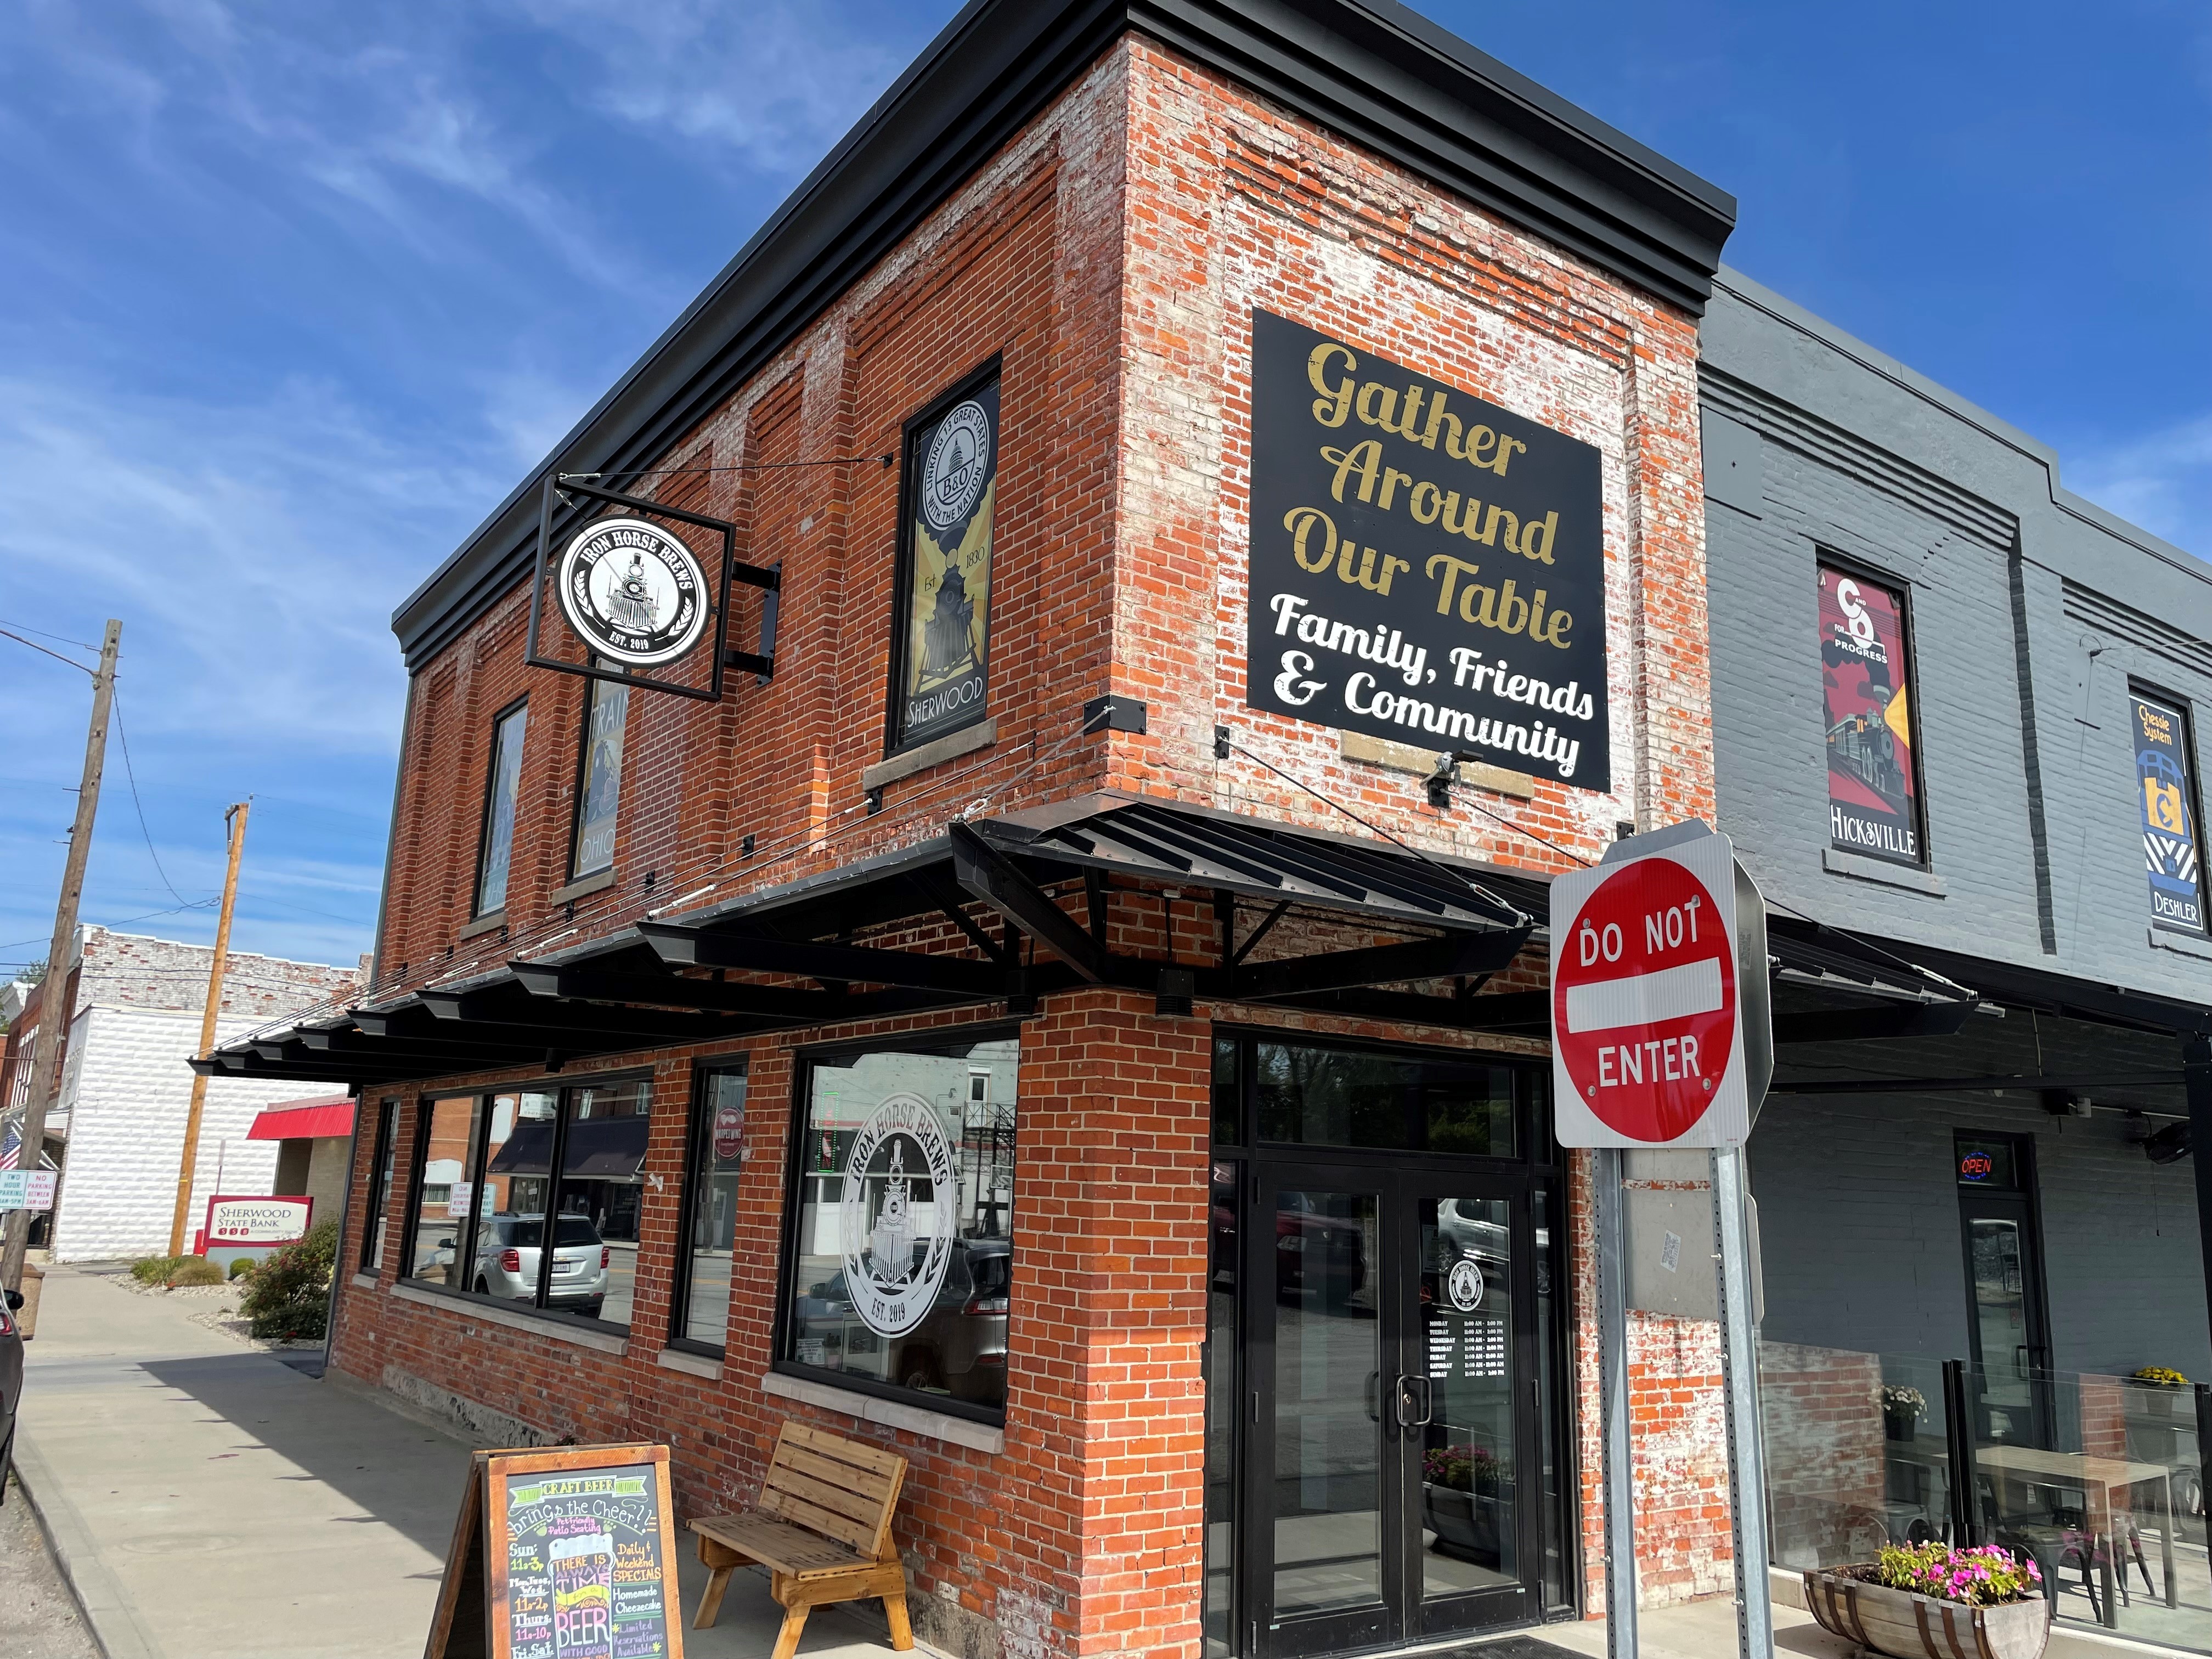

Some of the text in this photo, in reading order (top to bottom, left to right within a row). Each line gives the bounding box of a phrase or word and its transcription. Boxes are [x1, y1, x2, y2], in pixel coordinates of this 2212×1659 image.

[1307, 342, 1526, 476] Gather
[927, 409, 985, 492] LINKING 13 GREAT STATES
[928, 467, 981, 523] WITH THE NATION
[943, 467, 968, 498] B&O
[1320, 440, 1559, 565] Around
[580, 531, 693, 590] IRON HORSE BREWS
[966, 546, 985, 569] 1830
[924, 574, 936, 591] Est
[1283, 507, 1574, 649] Our Table
[1855, 597, 1866, 606] AND
[609, 631, 648, 650] EST. 2019
[1835, 639, 1888, 664] PROGRESS
[1270, 594, 1594, 720] Family, Friends
[907, 677, 983, 728] SHERWOOD
[1273, 650, 1579, 777] & Community
[2138, 704, 2170, 731] Chessie
[2144, 721, 2172, 746] System
[1830, 804, 1916, 856] HICKSVILLE
[580, 828, 616, 864] OHIO
[2154, 891, 2198, 922] DESHLER
[1580, 923, 1623, 967] DO
[1646, 901, 1701, 955] NOT
[1598, 1035, 1701, 1087] ENTER
[850, 1126, 875, 1184] IRON
[875, 1103, 915, 1139] HORSE
[915, 1111, 948, 1186] BREWS
[1962, 1159, 1992, 1173] OPEN
[218, 1218, 279, 1227] STATE BANK
[219, 1207, 291, 1217] SHERWOOD
[871, 1297, 906, 1323] EST. 2019
[543, 1480, 614, 1495] CRAFT BEER
[507, 1504, 563, 1534] brings
[567, 1500, 588, 1515] the
[548, 1523, 601, 1534] Patio Seating
[552, 1554, 606, 1572] THERE IS
[615, 1554, 654, 1569] Weekend
[617, 1541, 645, 1561] Daily
[556, 1564, 610, 1580] ALWAYS
[556, 1572, 610, 1593] TIME
[613, 1567, 662, 1582] SPECIALS
[613, 1585, 657, 1601] Homemade
[556, 1607, 610, 1647] BEER
[613, 1631, 663, 1645] Reservations
[619, 1618, 653, 1634] Limited
[560, 1647, 583, 1657] WITH
[585, 1644, 608, 1655] GOOD
[617, 1643, 653, 1657] Available
